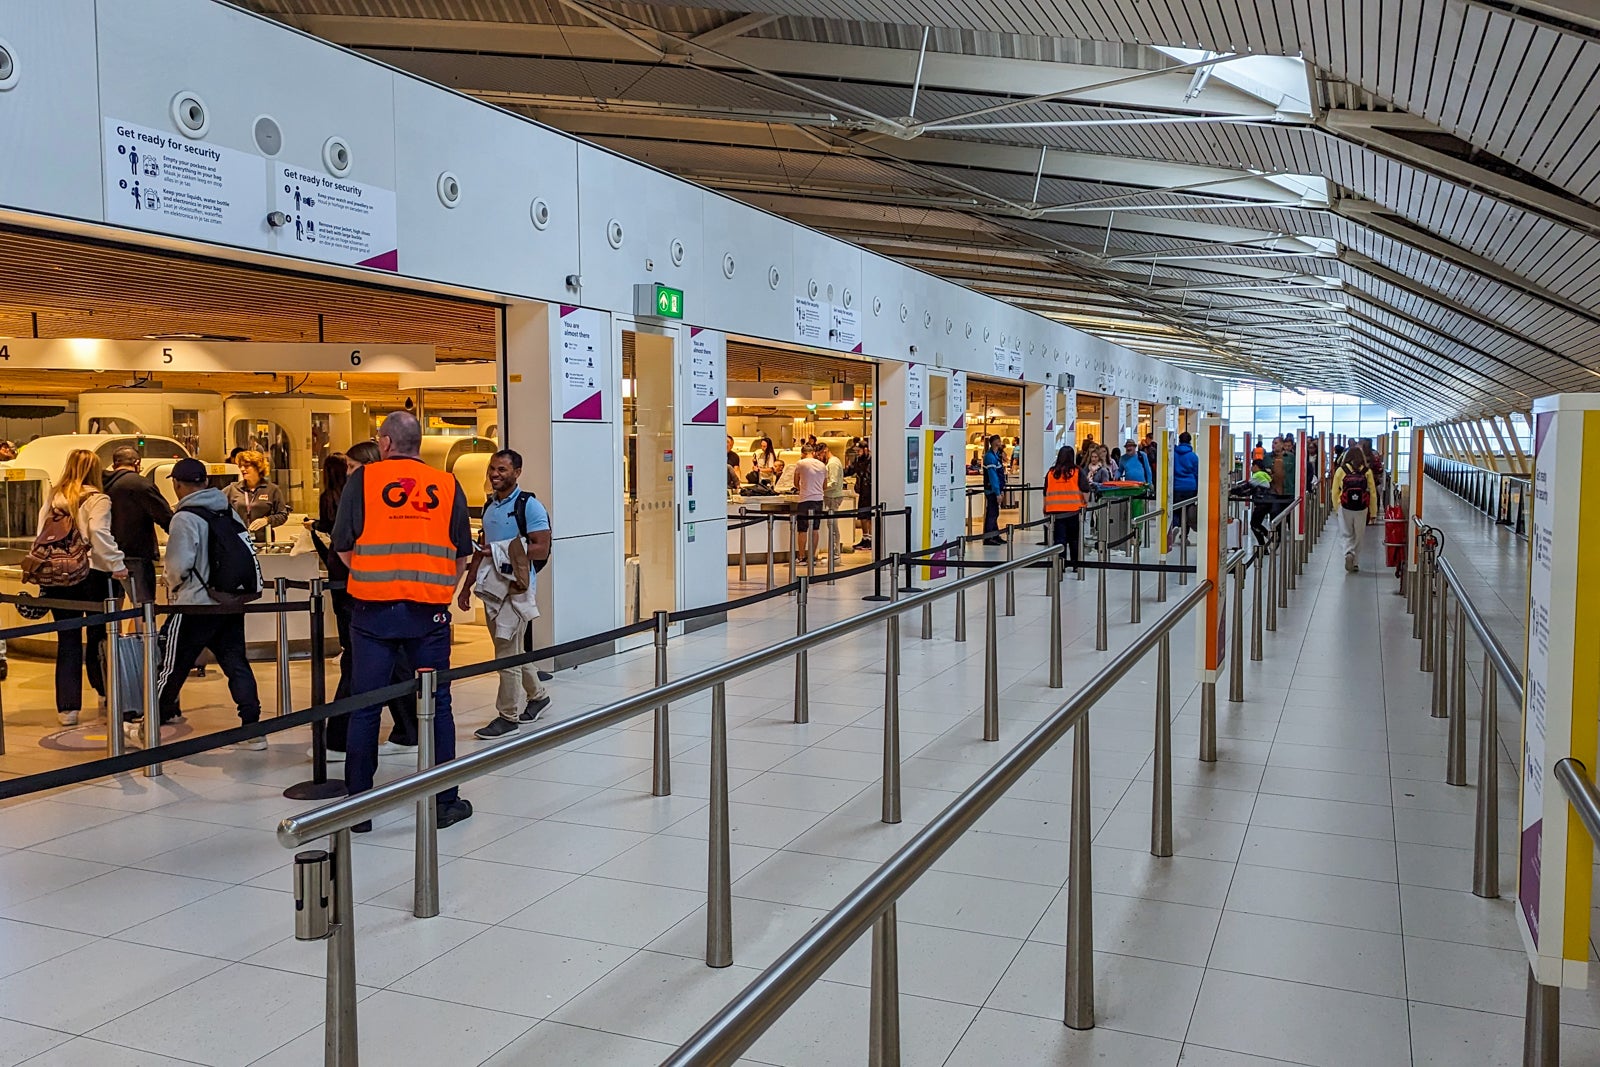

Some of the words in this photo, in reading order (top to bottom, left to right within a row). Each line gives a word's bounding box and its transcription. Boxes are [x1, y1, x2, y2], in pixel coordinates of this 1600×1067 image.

[117, 126, 135, 139] Get
[137, 133, 165, 148] ready
[168, 138, 182, 150] for
[184, 144, 220, 162] security
[163, 155, 178, 164] Empty
[172, 165, 196, 175] everything
[284, 168, 298, 179] Get
[300, 174, 320, 187] ready
[322, 178, 333, 188] for
[335, 183, 362, 197] security
[173, 198, 196, 206] electronics
[187, 193, 202, 201] liquids,
[0, 345, 10, 360] 4
[162, 348, 173, 364] 5
[351, 350, 361, 366] 6
[774, 386, 779, 395] 6
[382, 478, 439, 513] G4S
[433, 613, 446, 624] G4S
